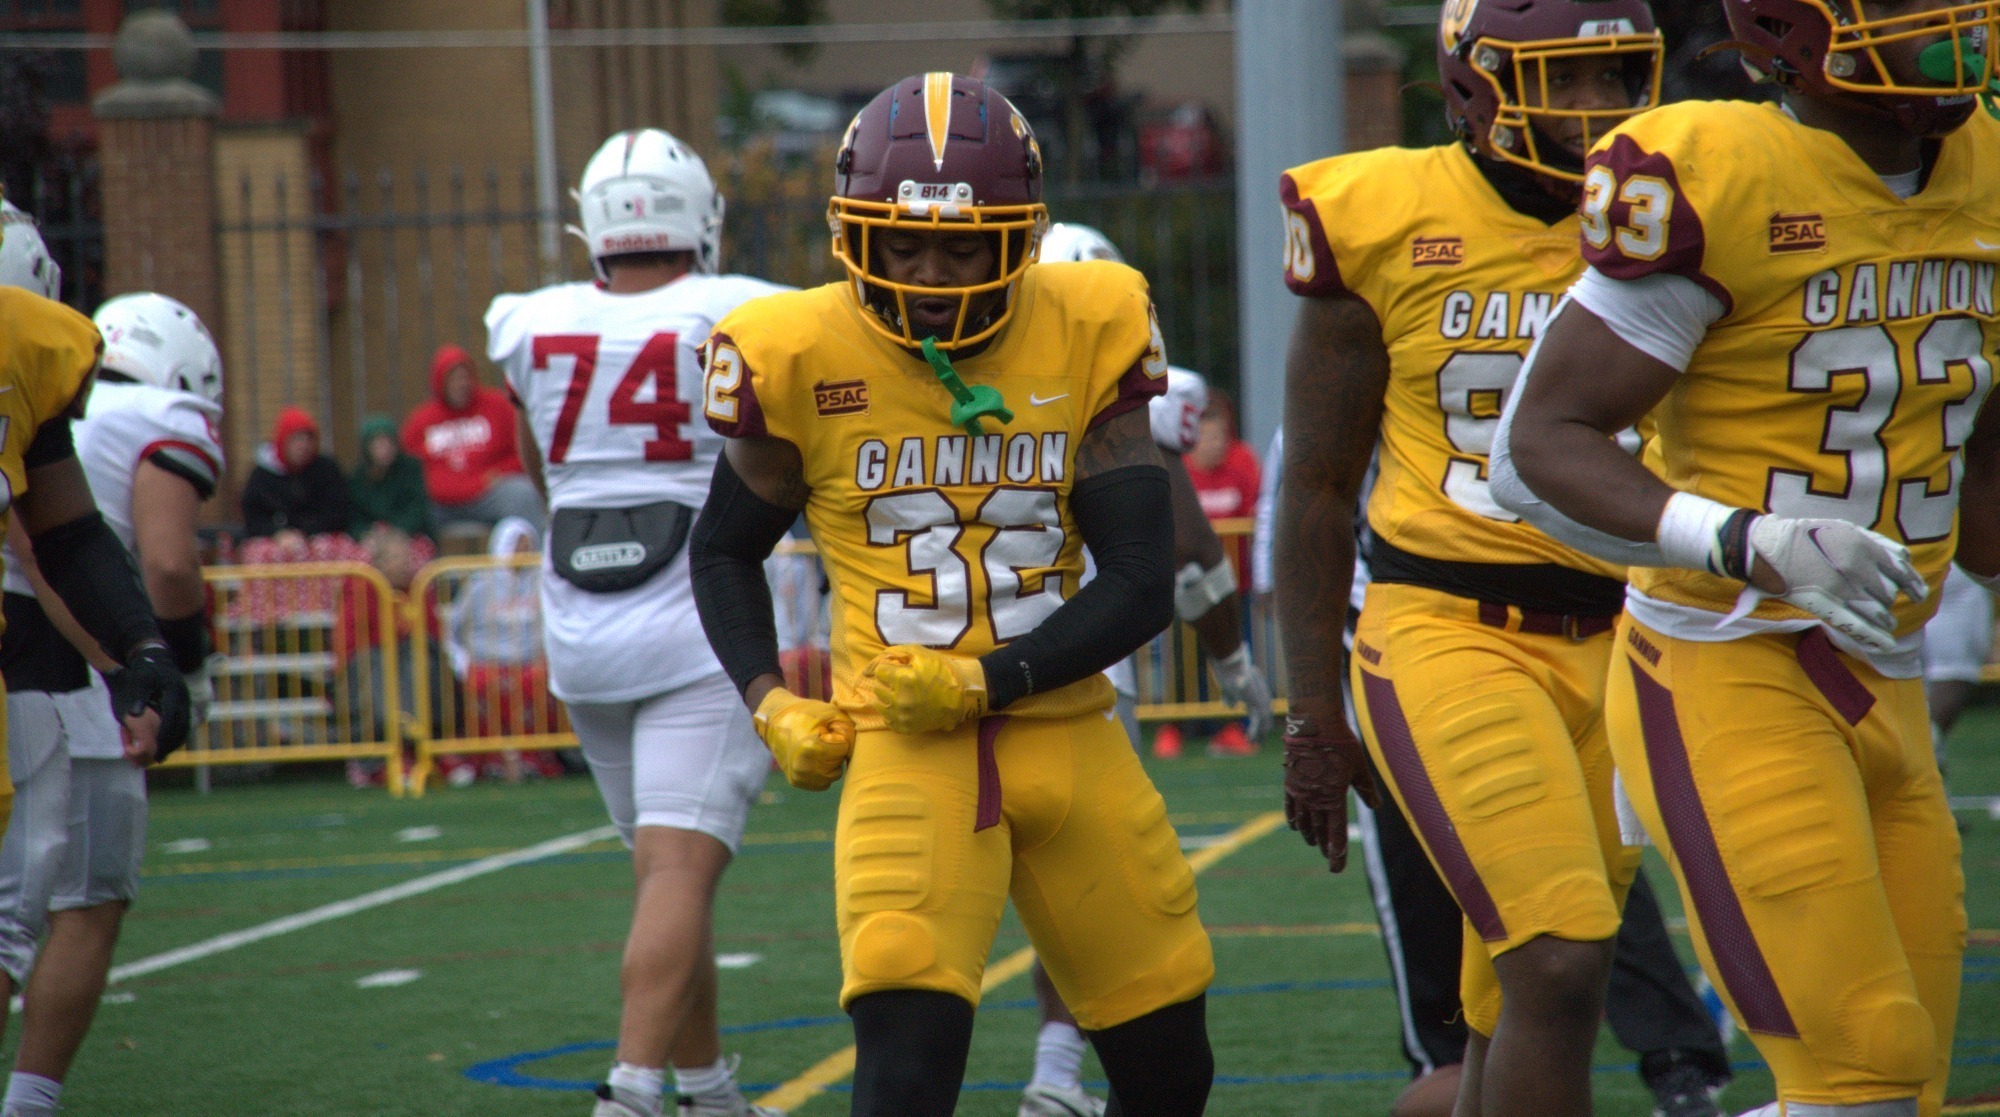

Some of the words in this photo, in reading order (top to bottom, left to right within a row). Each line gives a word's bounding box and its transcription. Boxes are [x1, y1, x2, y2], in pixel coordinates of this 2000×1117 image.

[921, 185, 949, 199] 814
[1579, 164, 1675, 262] 33
[1412, 245, 1463, 260] PSAC
[1769, 222, 1826, 243] PSAC
[1440, 290, 1568, 339] GAN
[1803, 259, 1996, 327] GANNON
[532, 331, 694, 465] 74
[815, 388, 869, 408] PSAC
[1763, 315, 1993, 544] 33
[856, 431, 1068, 490] GANNON
[863, 485, 1067, 650] 32
